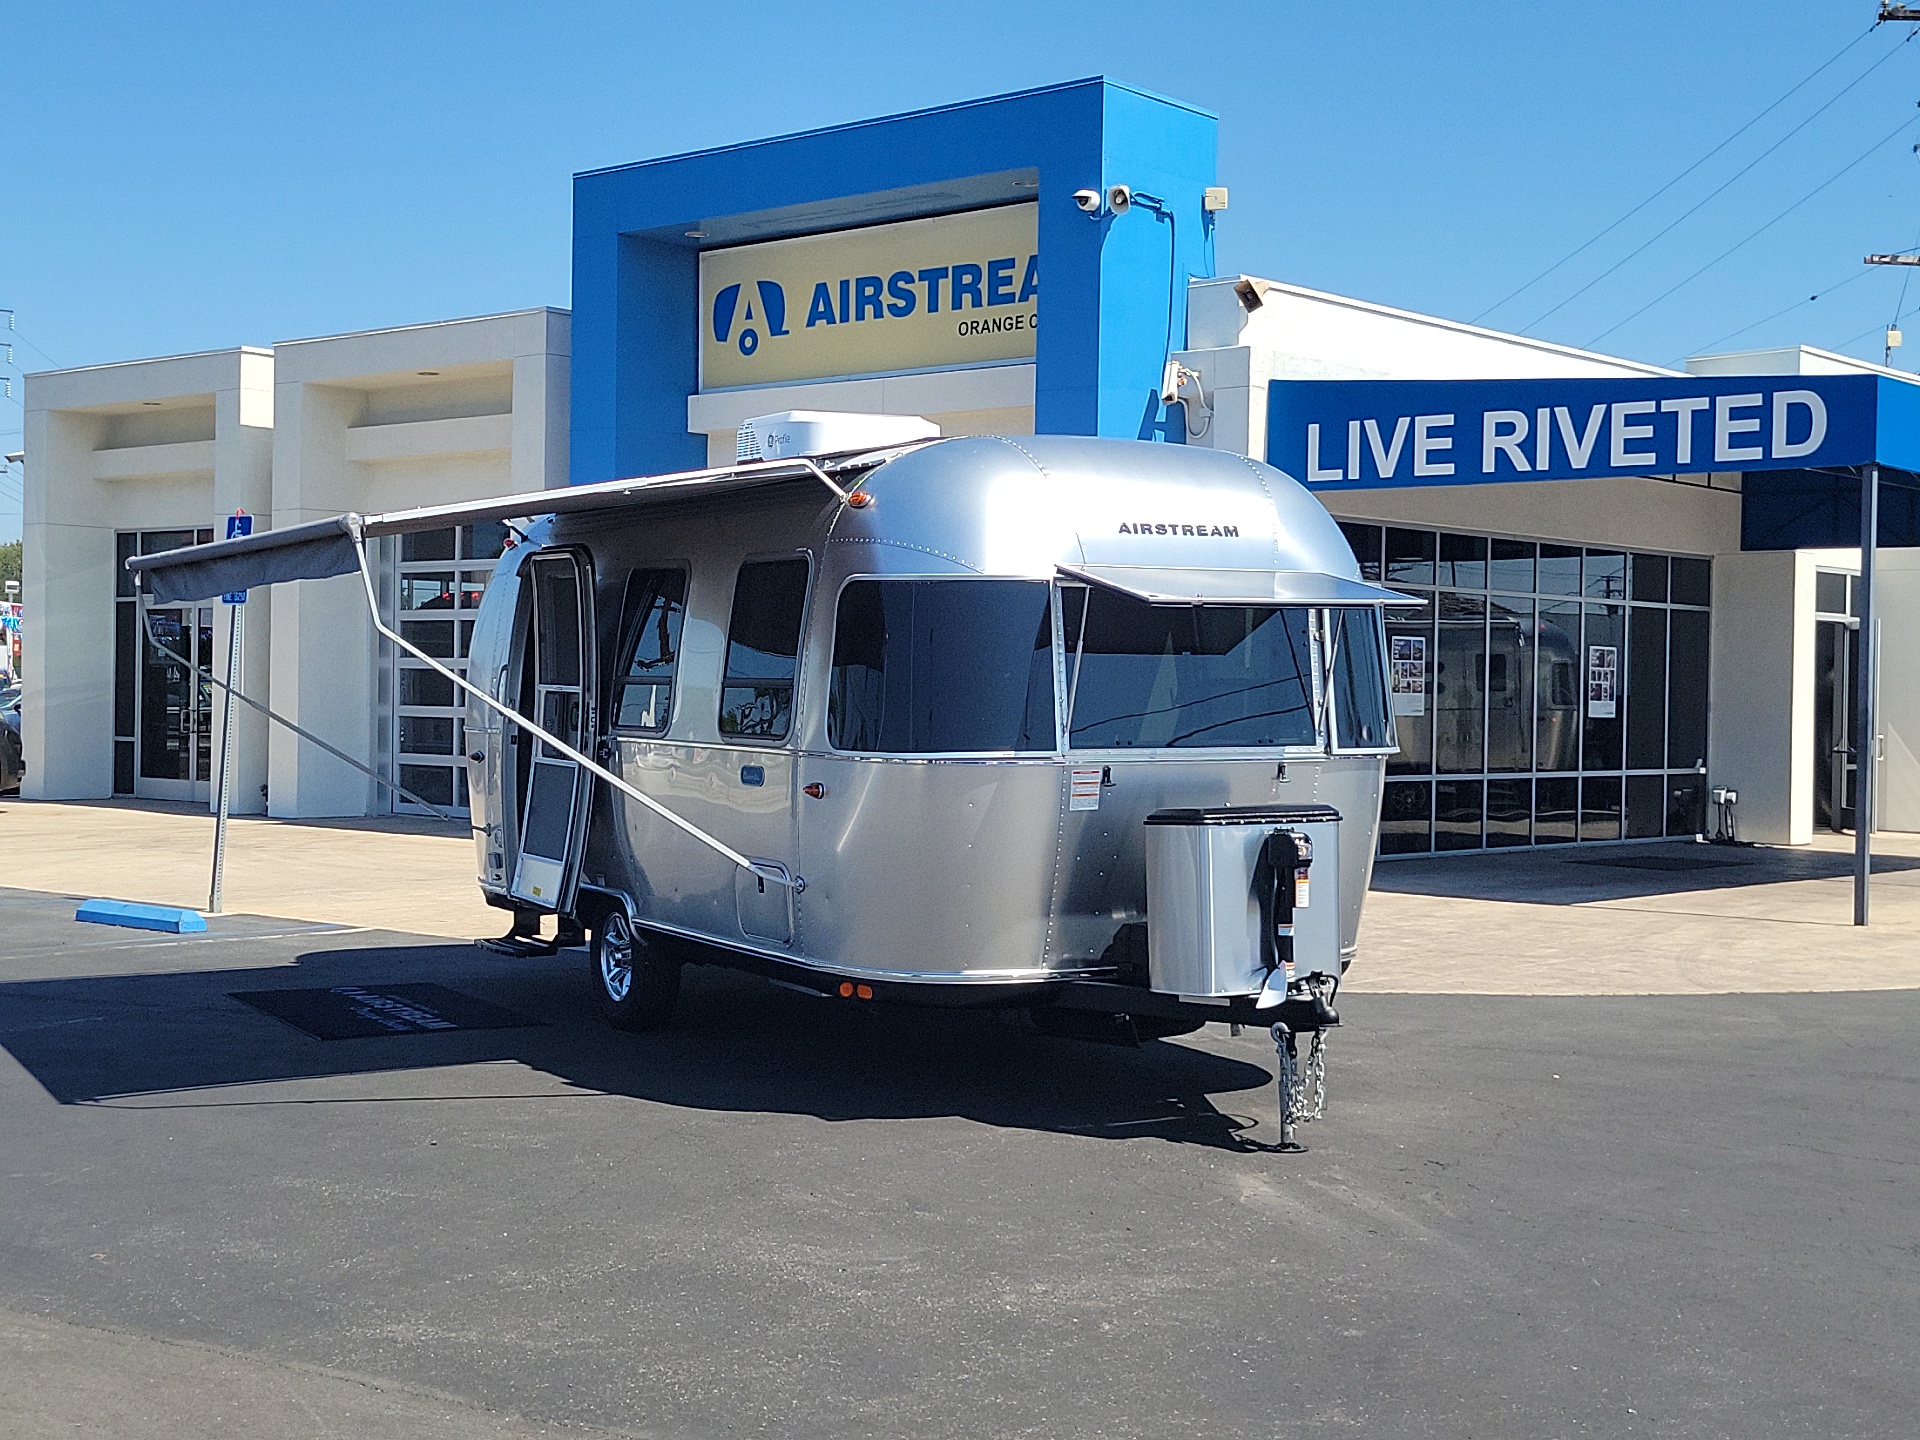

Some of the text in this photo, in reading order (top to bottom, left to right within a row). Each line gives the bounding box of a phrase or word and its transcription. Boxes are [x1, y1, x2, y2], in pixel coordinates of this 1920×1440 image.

[958, 314, 1024, 336] ORANGE
[1307, 389, 1828, 482] LIVE RIVETED
[1118, 521, 1239, 538] AIRSTREAM
